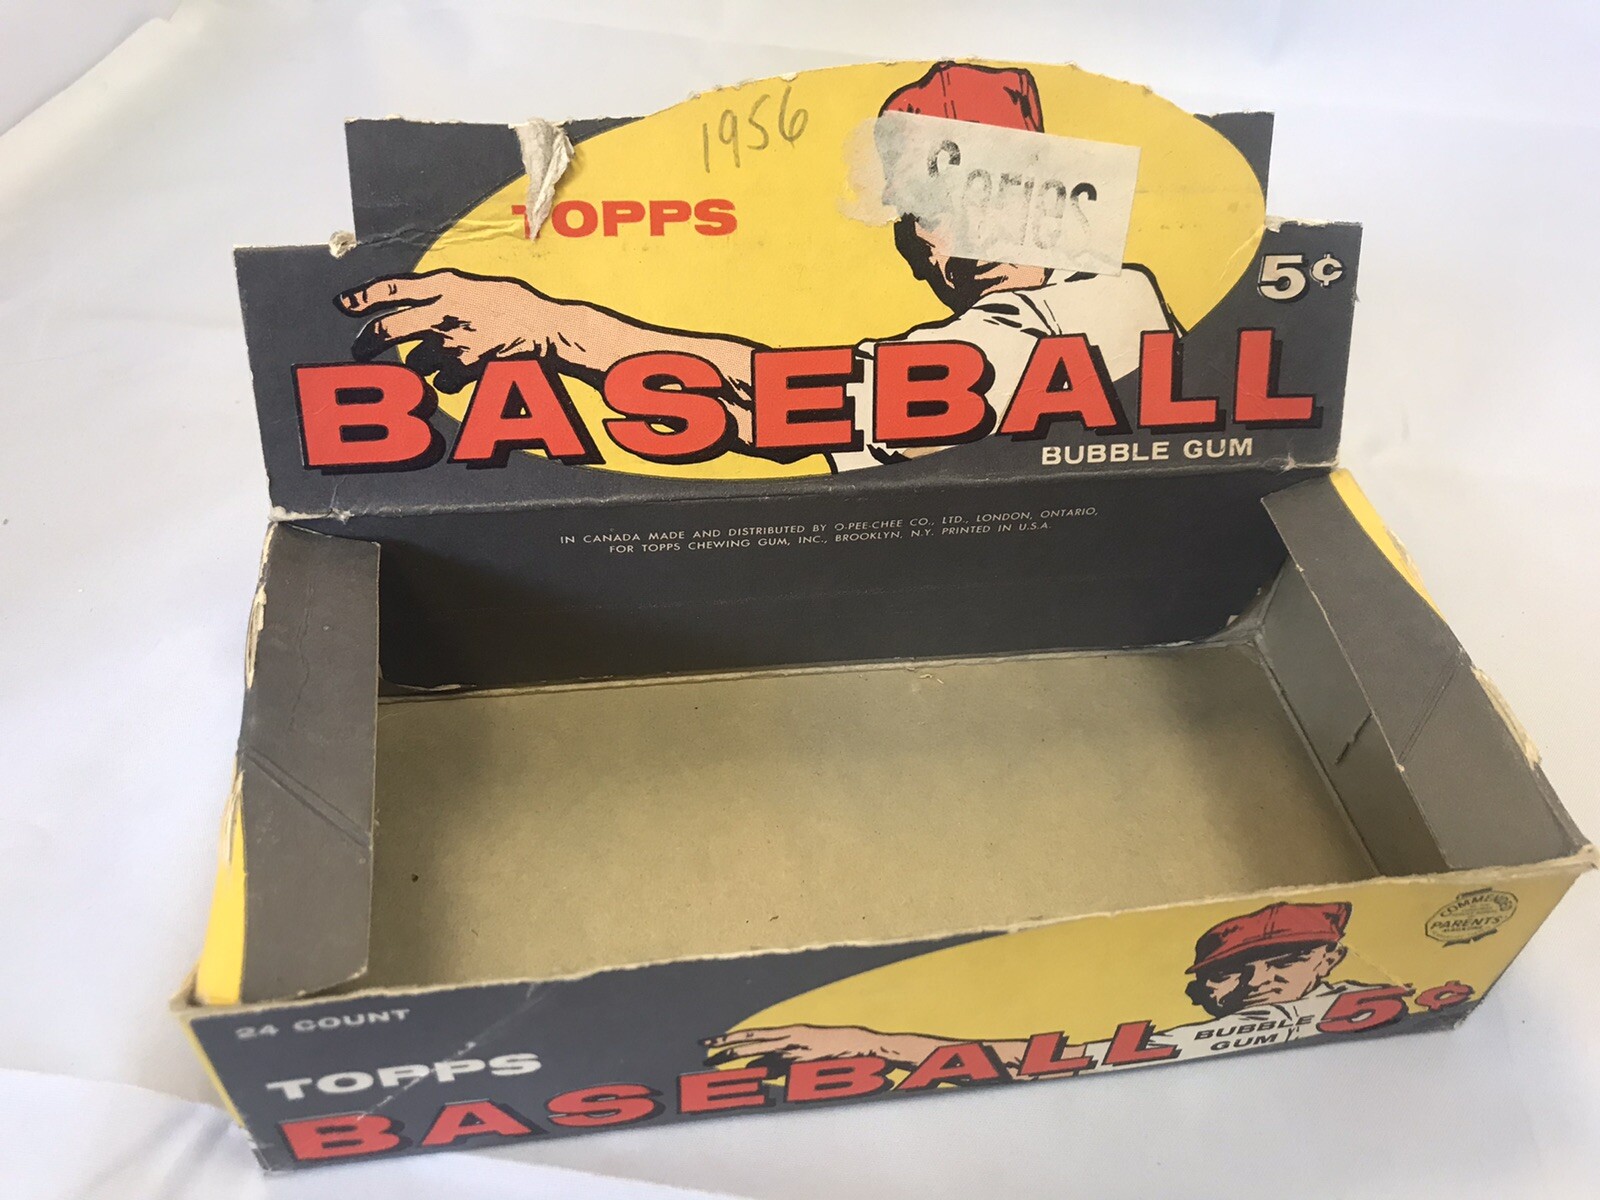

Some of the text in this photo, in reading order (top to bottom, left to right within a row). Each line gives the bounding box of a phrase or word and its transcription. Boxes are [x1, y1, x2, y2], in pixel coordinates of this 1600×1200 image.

[701, 86, 808, 172] 1956
[1257, 252, 1345, 301] 5¢
[294, 328, 1322, 474] BASEBALL
[1041, 437, 1254, 467] BUBBLE GUM
[560, 536, 575, 544] IN
[583, 532, 641, 543] CANADA
[648, 530, 685, 541] MADE
[692, 529, 721, 539] AND
[728, 524, 805, 537] DISTRIBUTED
[812, 523, 827, 533] BY
[909, 517, 935, 528] CO.,
[942, 514, 970, 526] LTD.,
[976, 511, 1034, 524] LONDON,
[1040, 507, 1099, 519] ONTARIO,
[609, 545, 634, 553] FOR
[642, 542, 681, 552] TOPPS
[688, 539, 750, 550] CHEWING
[757, 537, 791, 547] GUM,
[798, 534, 828, 545] INC.,
[835, 530, 903, 543] BROOKLYN,
[941, 524, 991, 535] PRINTED
[997, 524, 1012, 533] IN
[1440, 895, 1513, 918] COMME
[235, 1008, 411, 1040] 24 COUNT
[1194, 1014, 1315, 1041] BUBBLE
[1210, 1032, 1278, 1051] GUM
[265, 1052, 542, 1102] TOPPS
[279, 1020, 1180, 1163] BASEBALL
